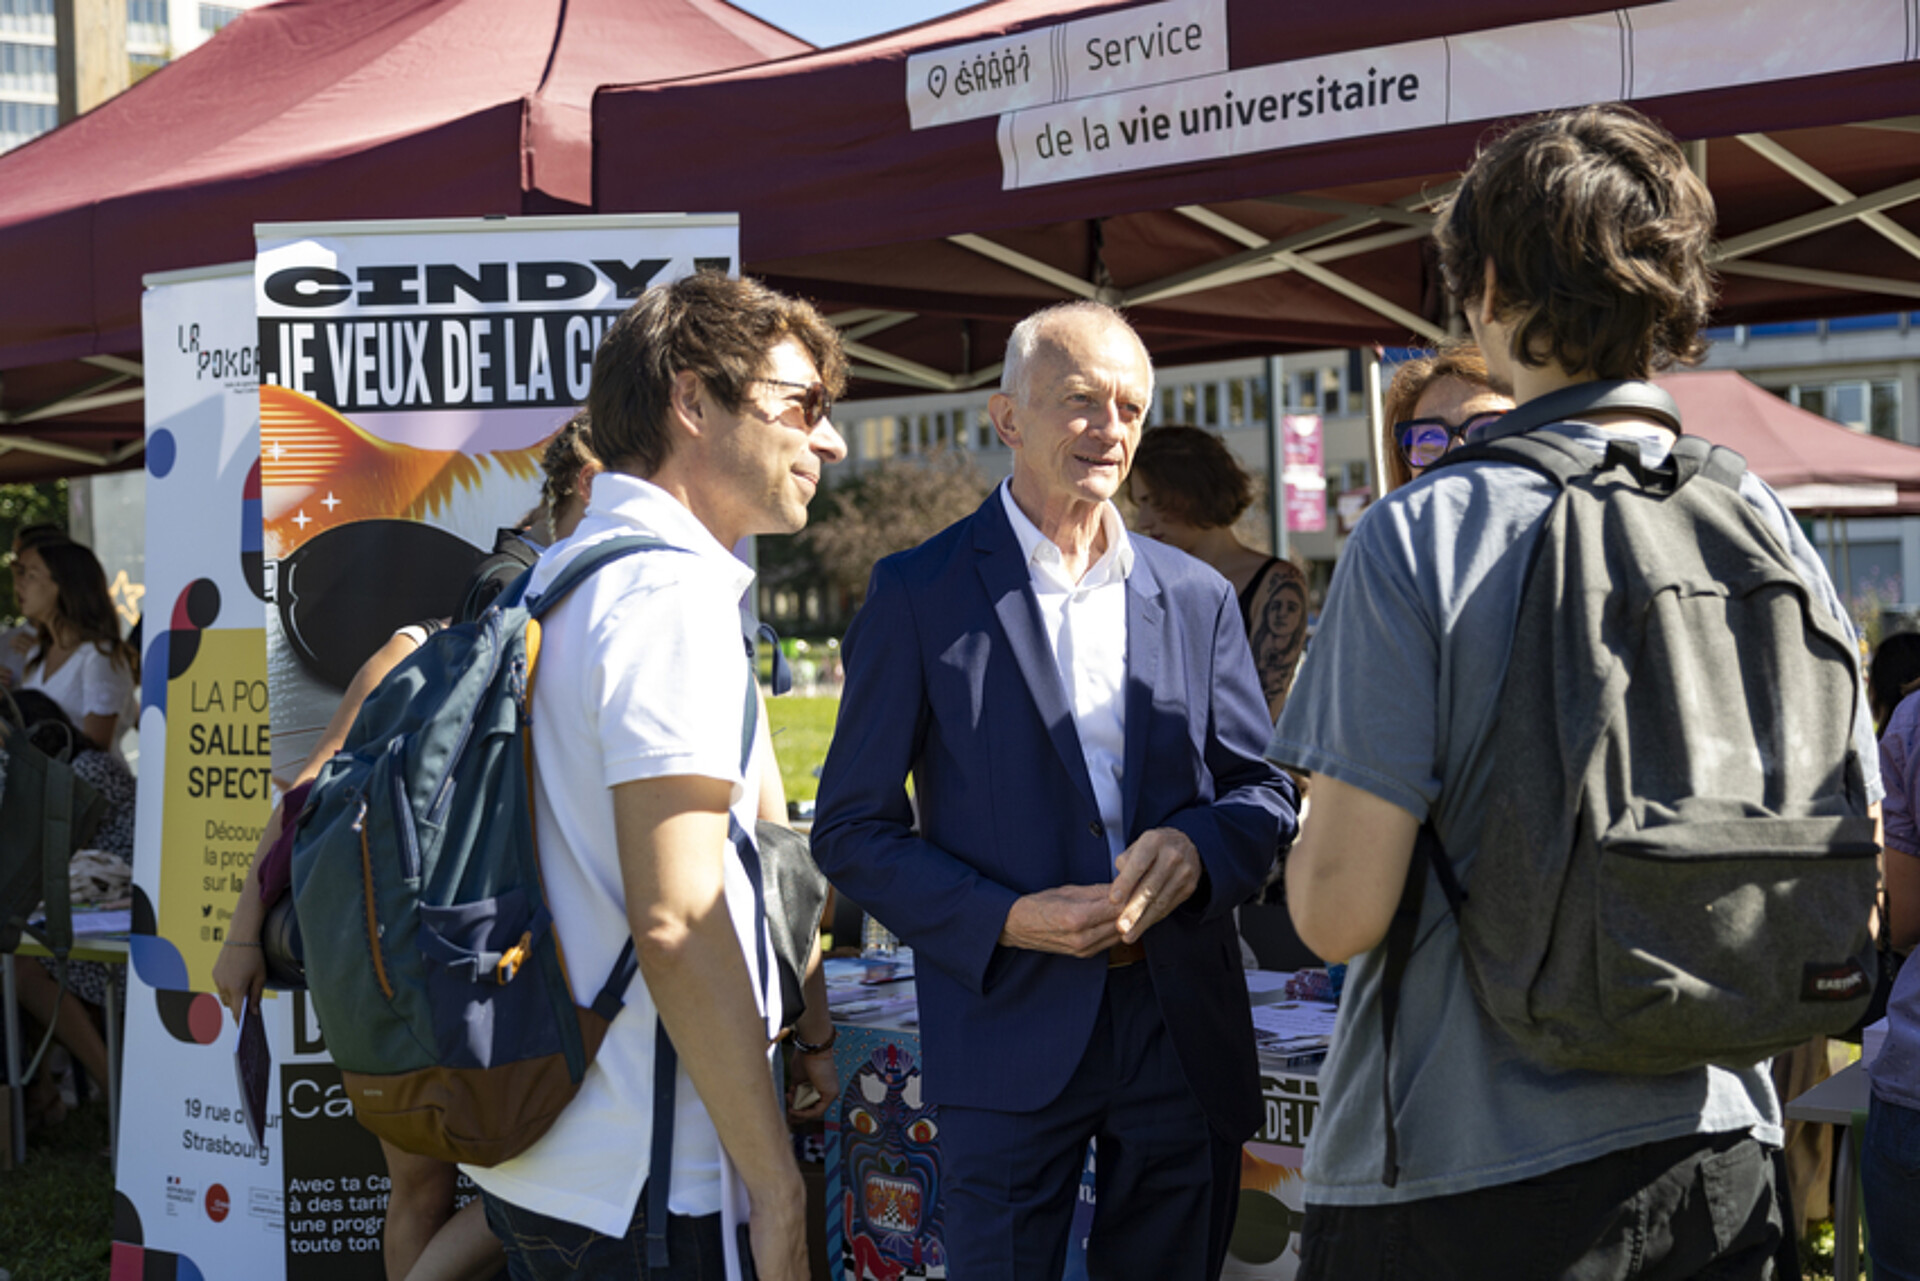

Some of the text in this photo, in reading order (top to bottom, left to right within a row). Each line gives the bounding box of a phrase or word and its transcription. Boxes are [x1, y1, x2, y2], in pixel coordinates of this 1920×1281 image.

[1086, 20, 1202, 71] Service
[1035, 66, 1420, 160] de la vie universitaire
[264, 256, 673, 307] CINDY
[266, 321, 316, 399] JE
[326, 319, 432, 407] VEUX
[441, 318, 494, 404] DE
[503, 316, 556, 402] LA
[191, 680, 226, 713] LA
[189, 722, 272, 756] SALLE
[187, 765, 272, 800] SPECT
[203, 845, 217, 867] la
[203, 876, 227, 892] sur
[184, 1098, 202, 1119] 19
[205, 1104, 231, 1123] rue
[1266, 1099, 1293, 1142] DE
[182, 1128, 270, 1167] Strasbourg
[289, 1177, 333, 1193] Avec
[340, 1176, 361, 1191] ta
[289, 1196, 302, 1214] à
[307, 1195, 344, 1213] des
[290, 1219, 326, 1234] une
[290, 1236, 381, 1253] toute ton
